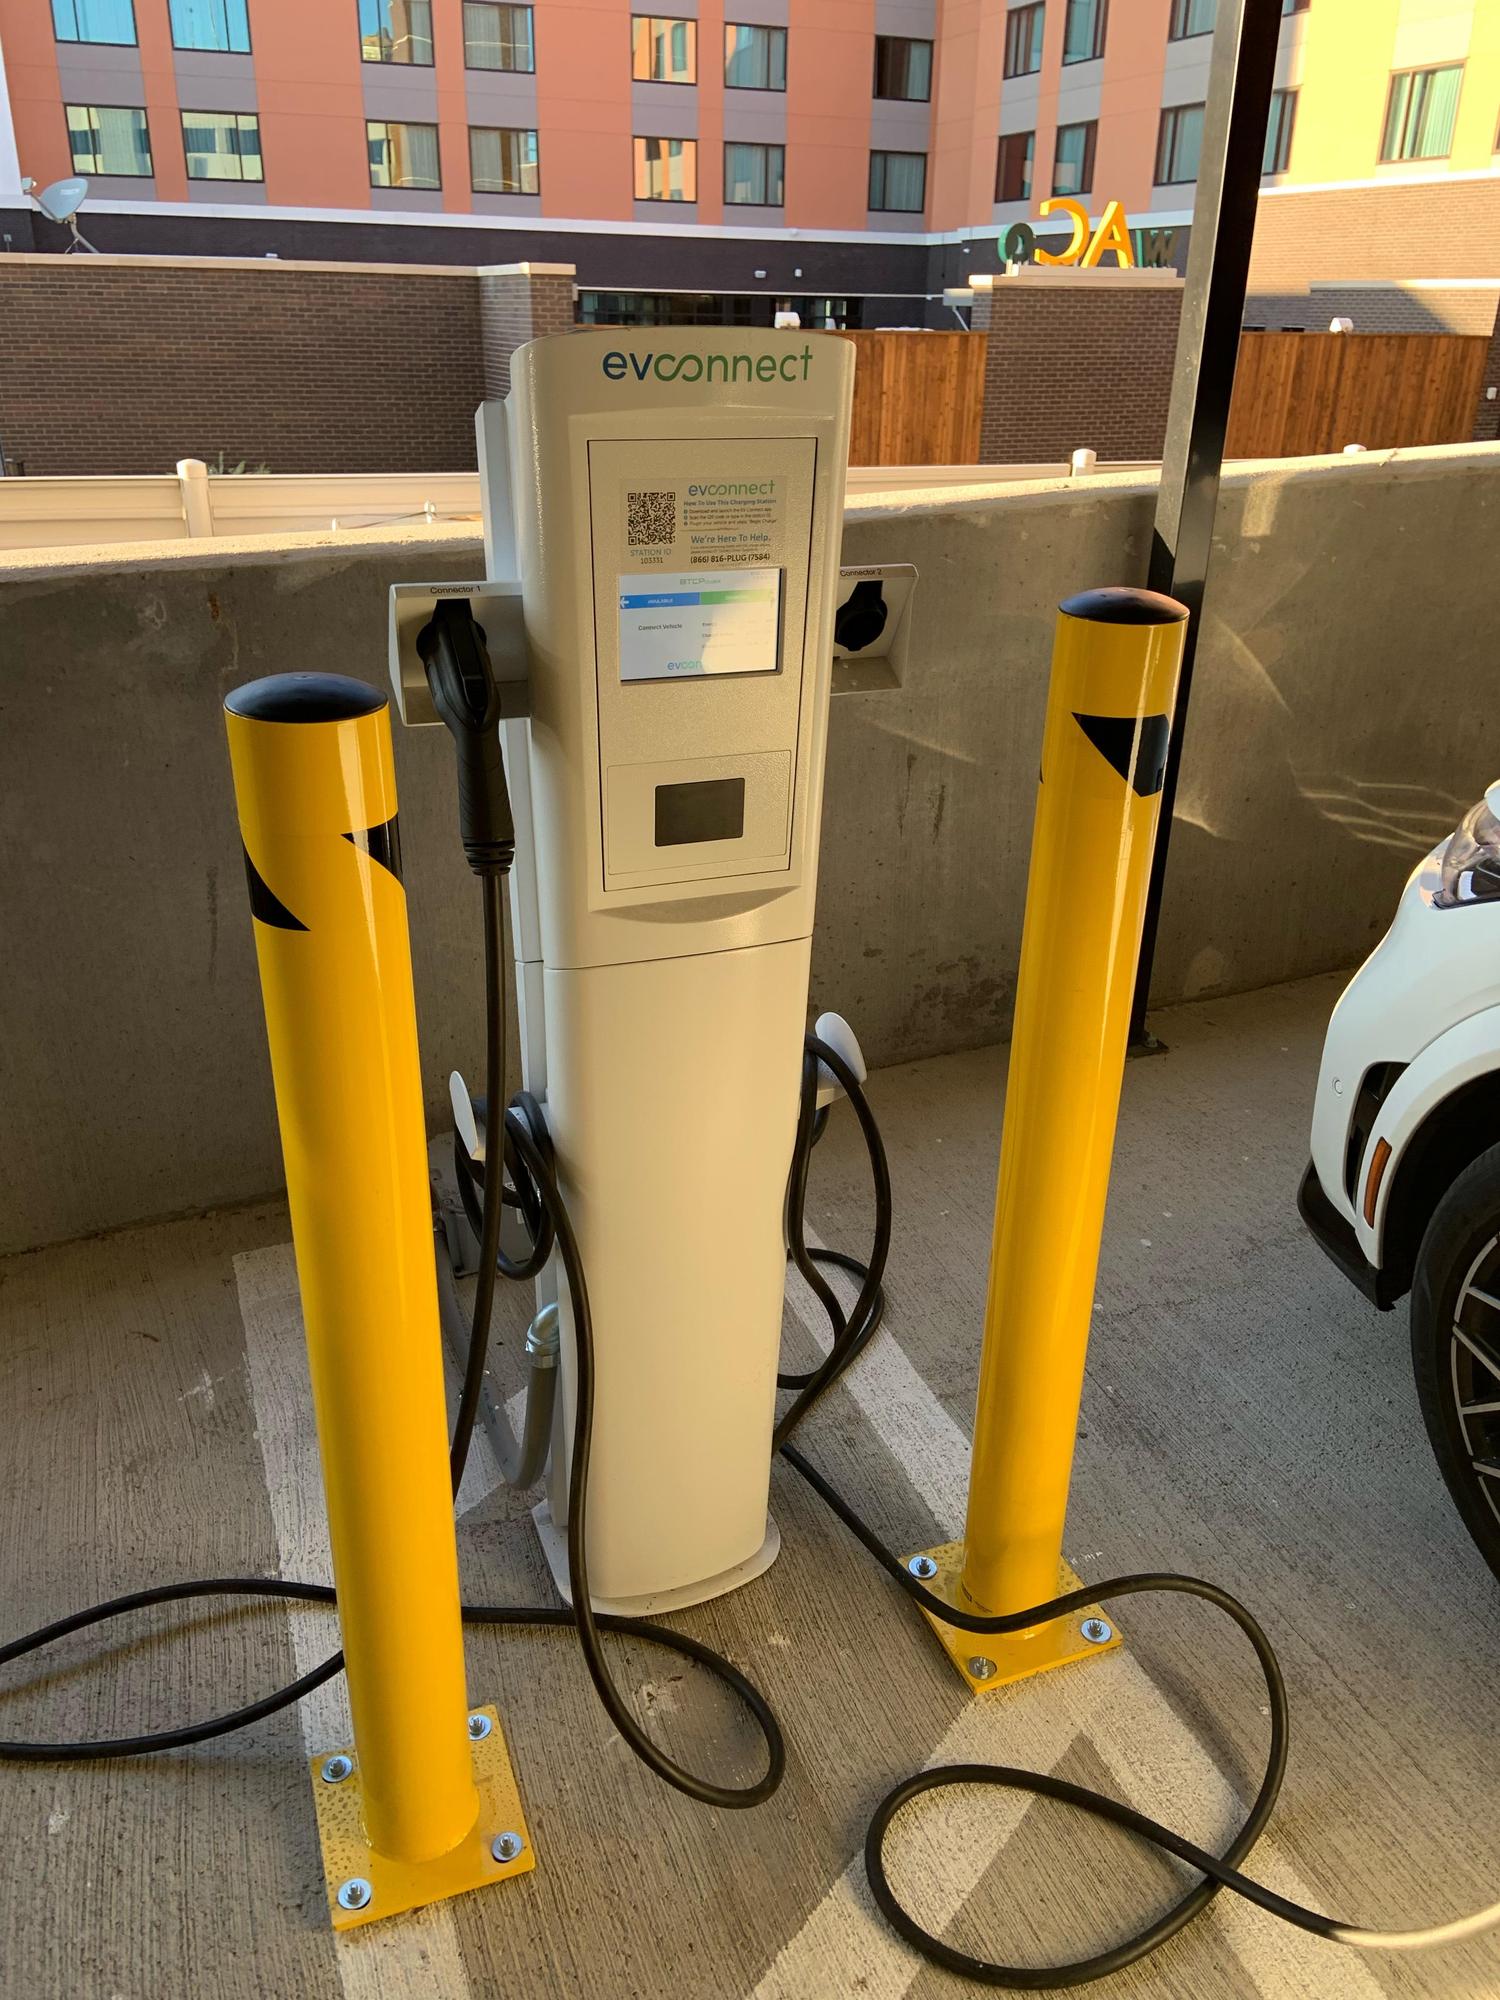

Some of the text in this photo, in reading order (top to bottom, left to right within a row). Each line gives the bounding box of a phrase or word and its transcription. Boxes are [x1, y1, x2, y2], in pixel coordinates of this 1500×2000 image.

[602, 345, 813, 382] evconnect
[688, 480, 775, 497] evconnect
[691, 535, 715, 543] We're
[717, 535, 737, 543] Here
[750, 533, 771, 542] Help.
[630, 548, 672, 557] STATION ID
[691, 553, 770, 564] (866) 816-PLUG (7584)
[840, 569, 876, 577] Connector
[430, 586, 474, 594] Connector
